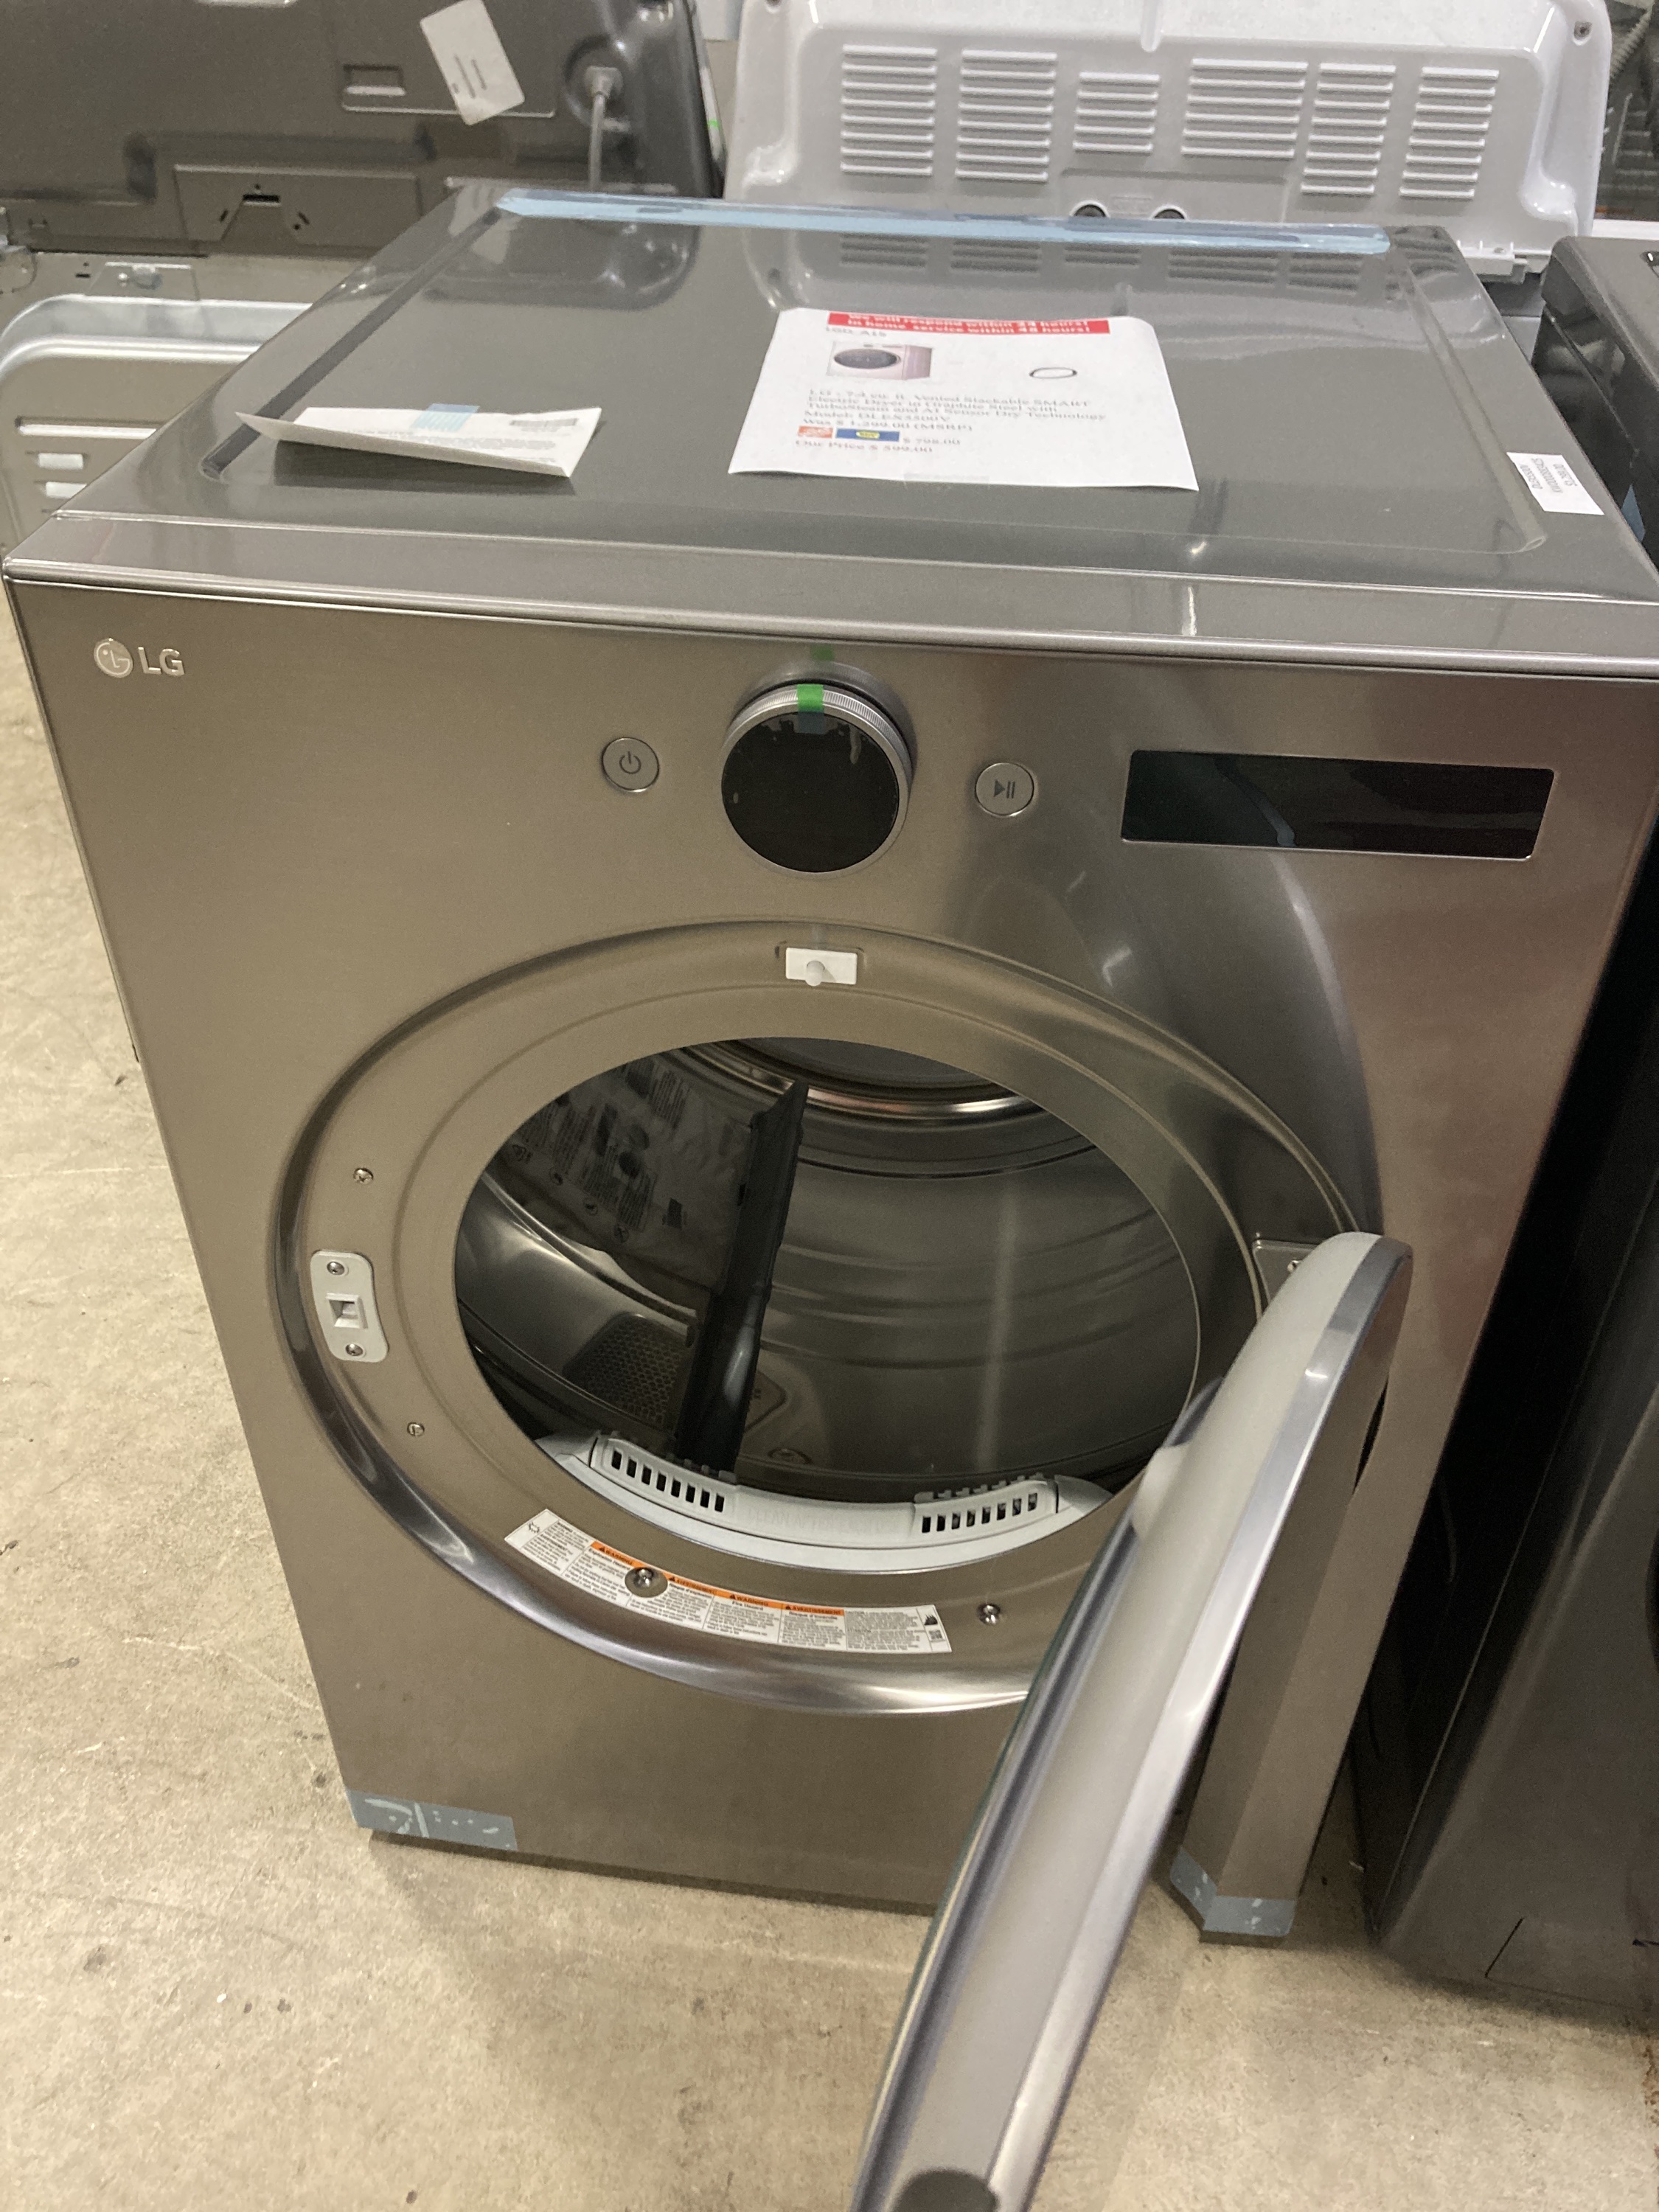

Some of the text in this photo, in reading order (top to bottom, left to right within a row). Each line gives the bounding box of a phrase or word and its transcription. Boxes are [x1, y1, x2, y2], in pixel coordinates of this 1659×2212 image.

[808, 396, 859, 405] Electric
[864, 398, 903, 407] Dryer
[988, 403, 1022, 411] Steel
[914, 394, 961, 403] Vented
[963, 397, 1030, 406] Stackable
[808, 403, 889, 412] TurboSteam
[995, 411, 1020, 419] Dry
[1026, 411, 1106, 421] Technology
[827, 442, 866, 450] Price
[138, 647, 184, 677] LG
